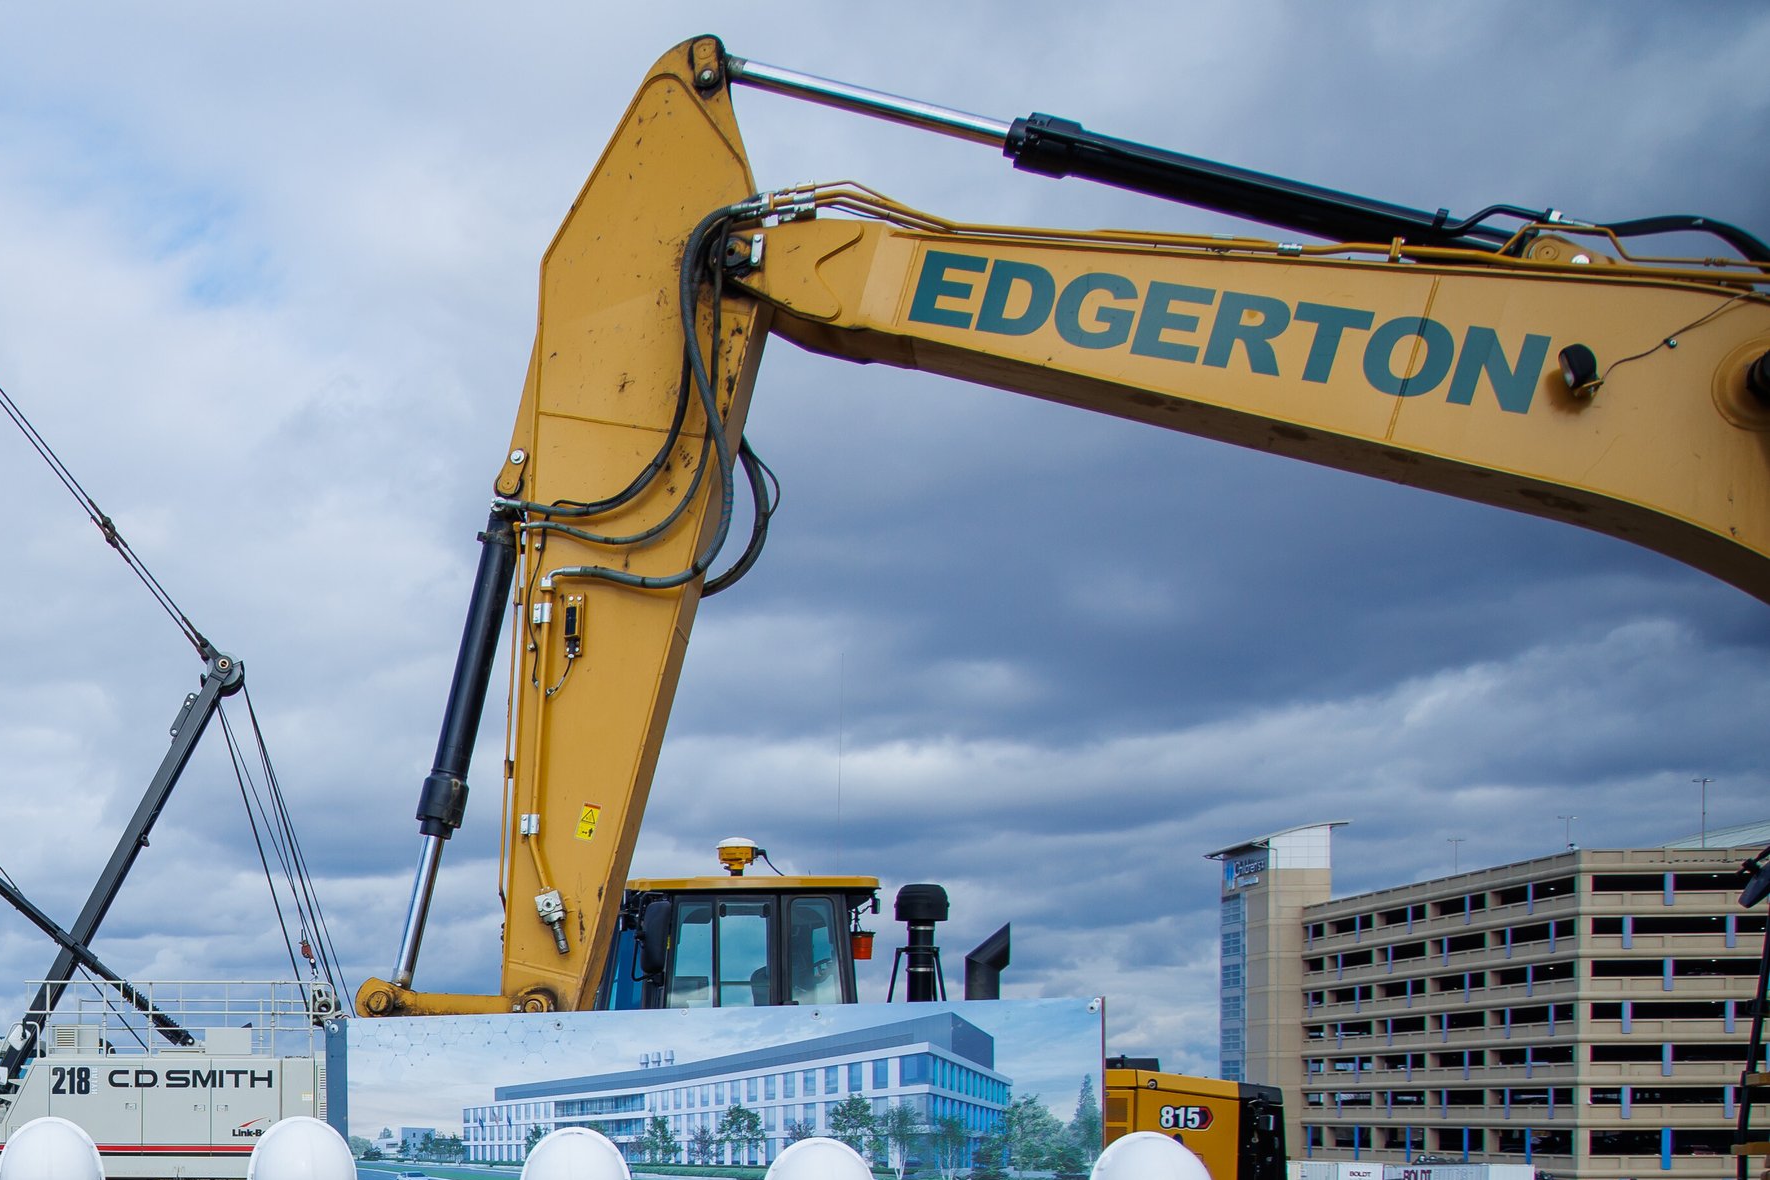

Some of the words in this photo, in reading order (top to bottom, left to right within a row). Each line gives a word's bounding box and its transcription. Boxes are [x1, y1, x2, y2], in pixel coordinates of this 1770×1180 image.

[908, 250, 1551, 415] EDGERTON
[51, 1066, 91, 1095] 218
[108, 1069, 159, 1088] C.D.
[165, 1069, 273, 1088] SMITH
[1160, 1106, 1200, 1129] 815
[1349, 1170, 1372, 1178] BOLDT
